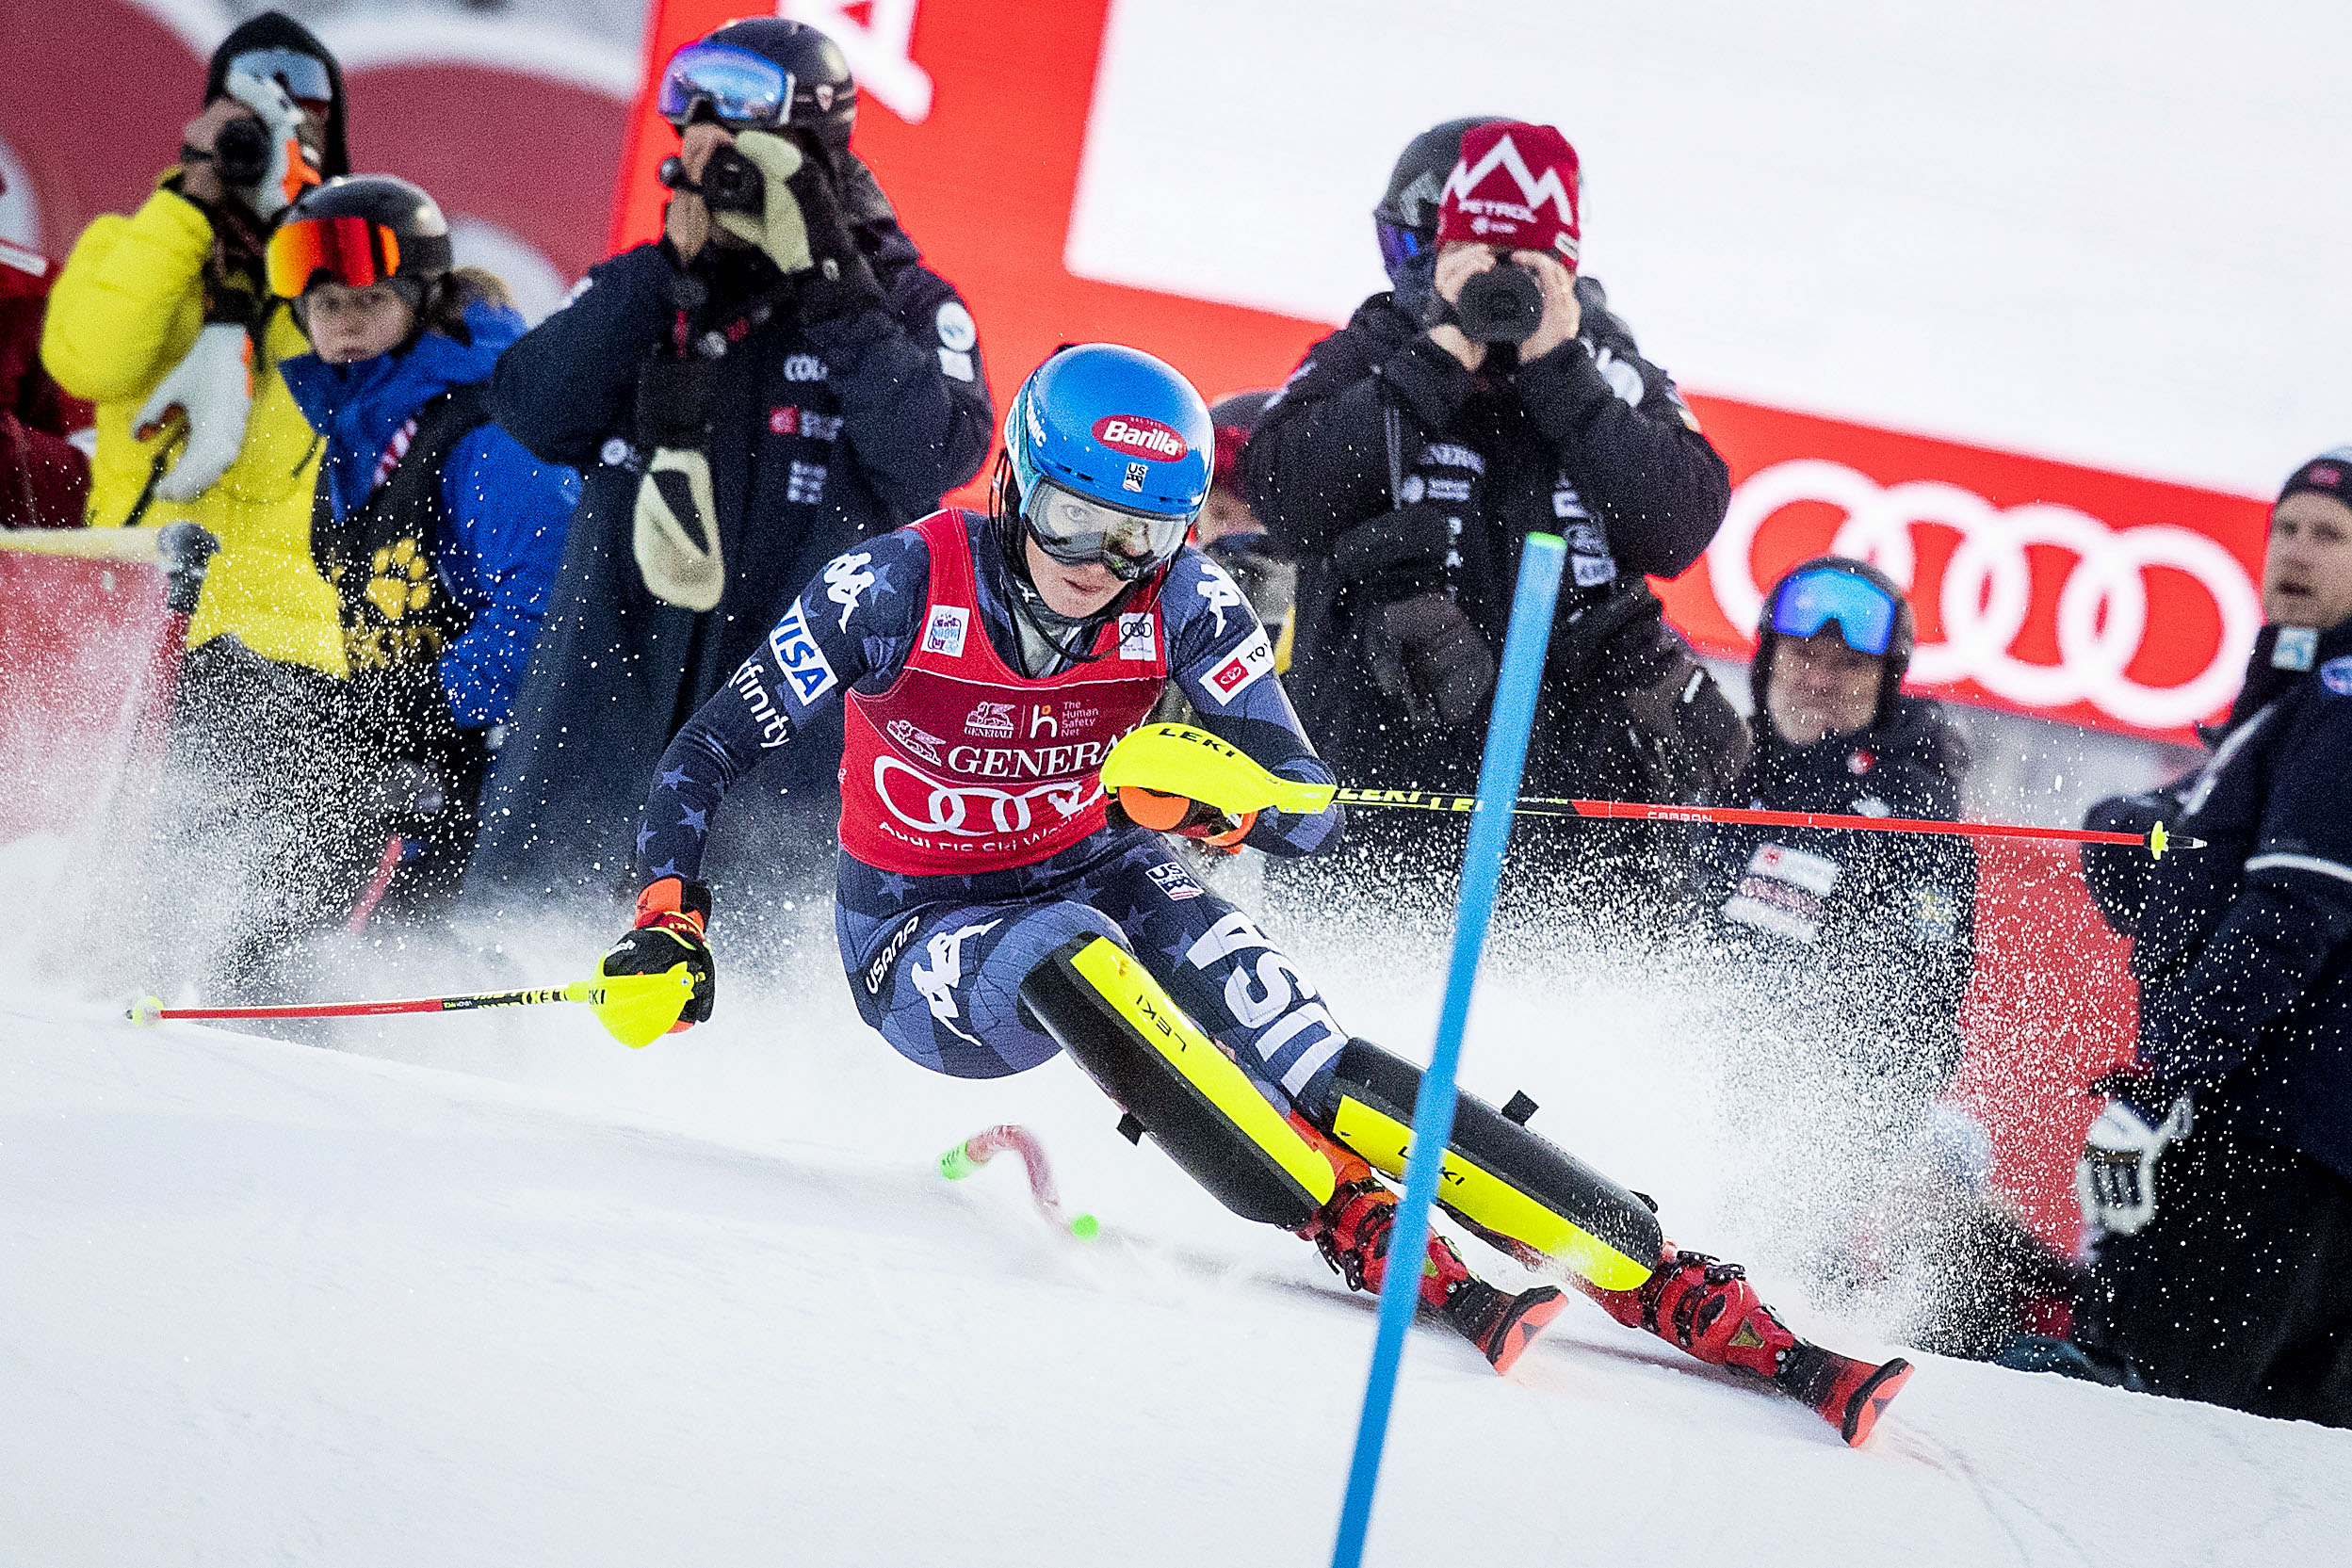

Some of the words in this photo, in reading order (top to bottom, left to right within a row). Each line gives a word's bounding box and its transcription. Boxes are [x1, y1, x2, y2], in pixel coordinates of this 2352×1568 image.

[1103, 420, 1179, 457] Barilla
[1128, 462, 1145, 476] US
[774, 610, 828, 698] VISA
[1062, 707, 1099, 719] Human
[1063, 701, 1081, 710] The
[964, 726, 1014, 739] GENERALI
[1061, 718, 1096, 729] Safety
[1061, 727, 1080, 737] Net
[947, 724, 1135, 779] GENERA
[1158, 727, 1236, 758] LEKI
[1148, 864, 1184, 880] US
[866, 915, 919, 994] USANA
[1185, 910, 1349, 1098] USA
[1136, 994, 1187, 1052] LEKI
[1398, 1145, 1466, 1187] LKI
